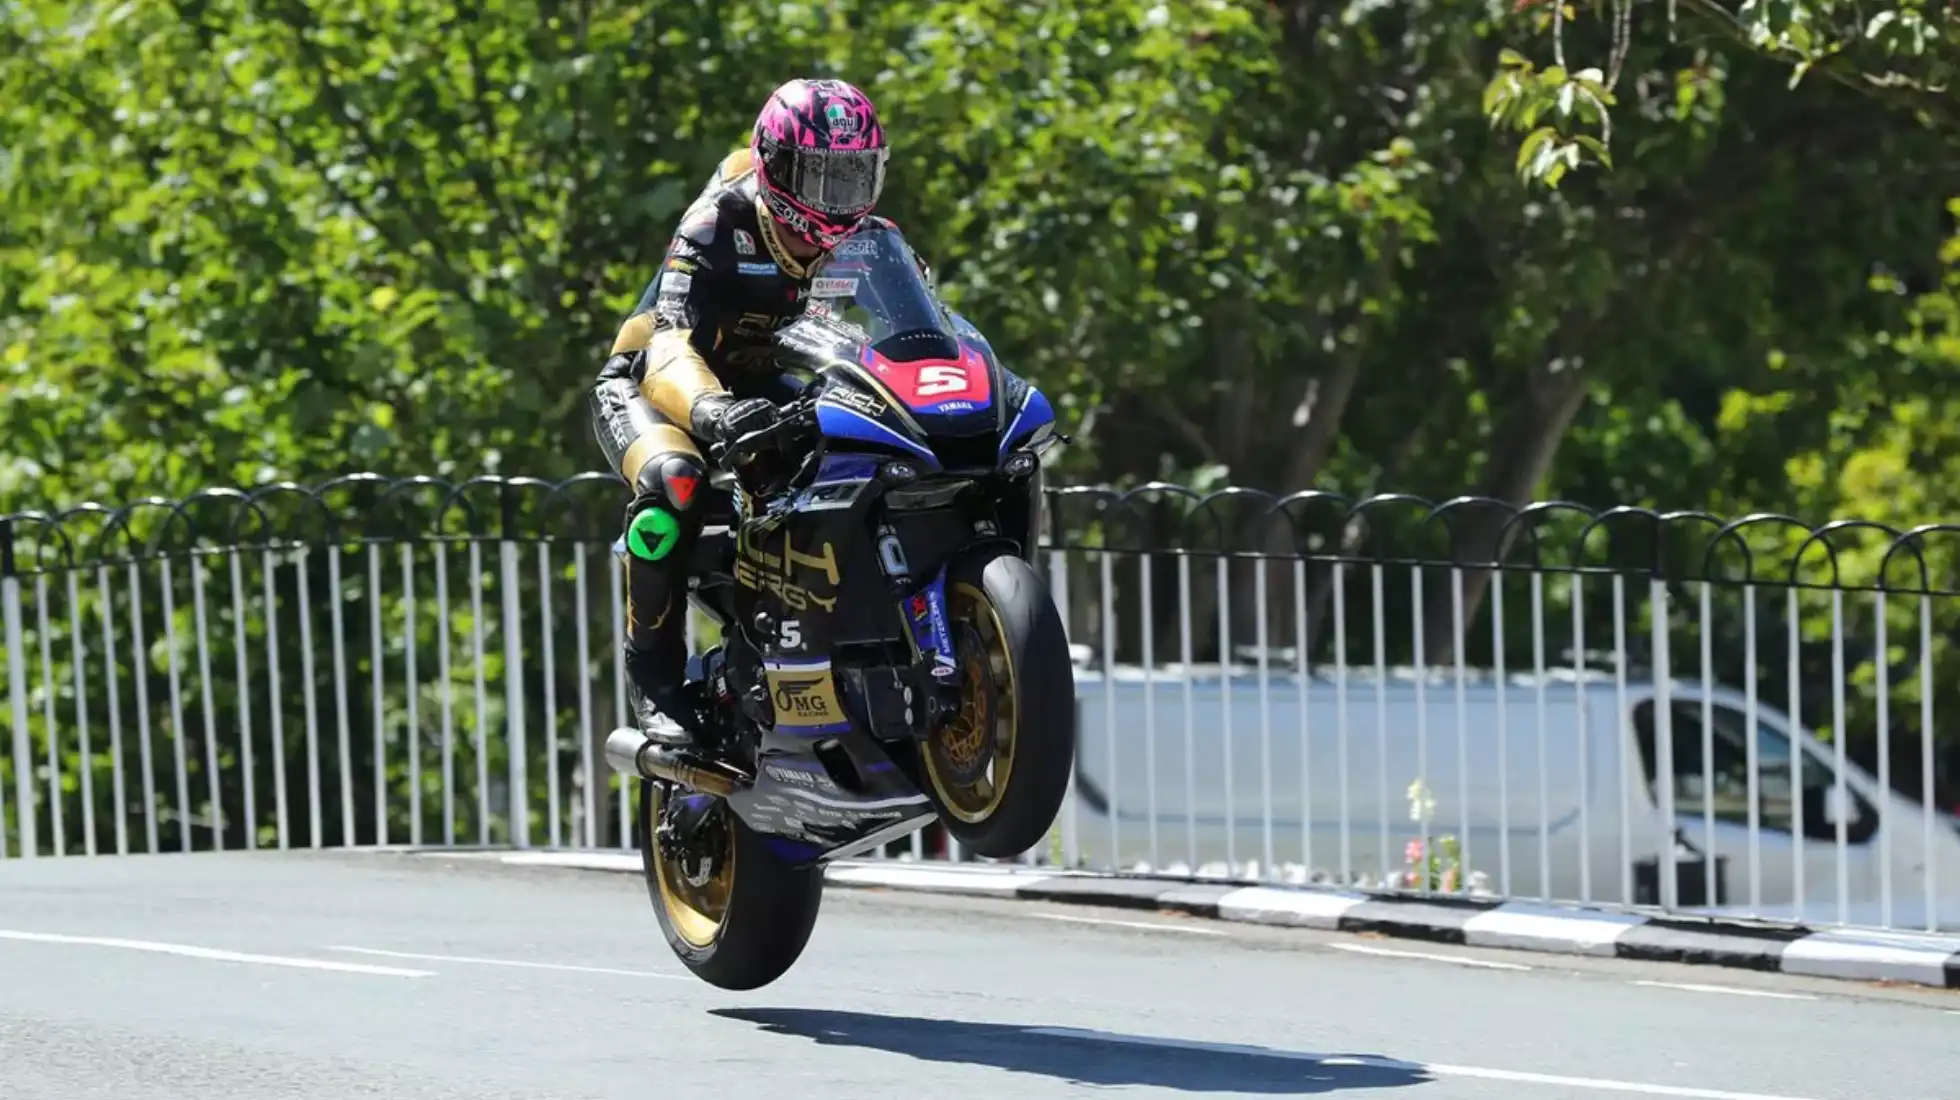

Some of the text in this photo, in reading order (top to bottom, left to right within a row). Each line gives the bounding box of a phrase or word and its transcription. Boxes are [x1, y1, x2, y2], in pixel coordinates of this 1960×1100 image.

[915, 365, 969, 397] 5
[937, 401, 974, 413] YAMAHA
[779, 619, 802, 649] 5
